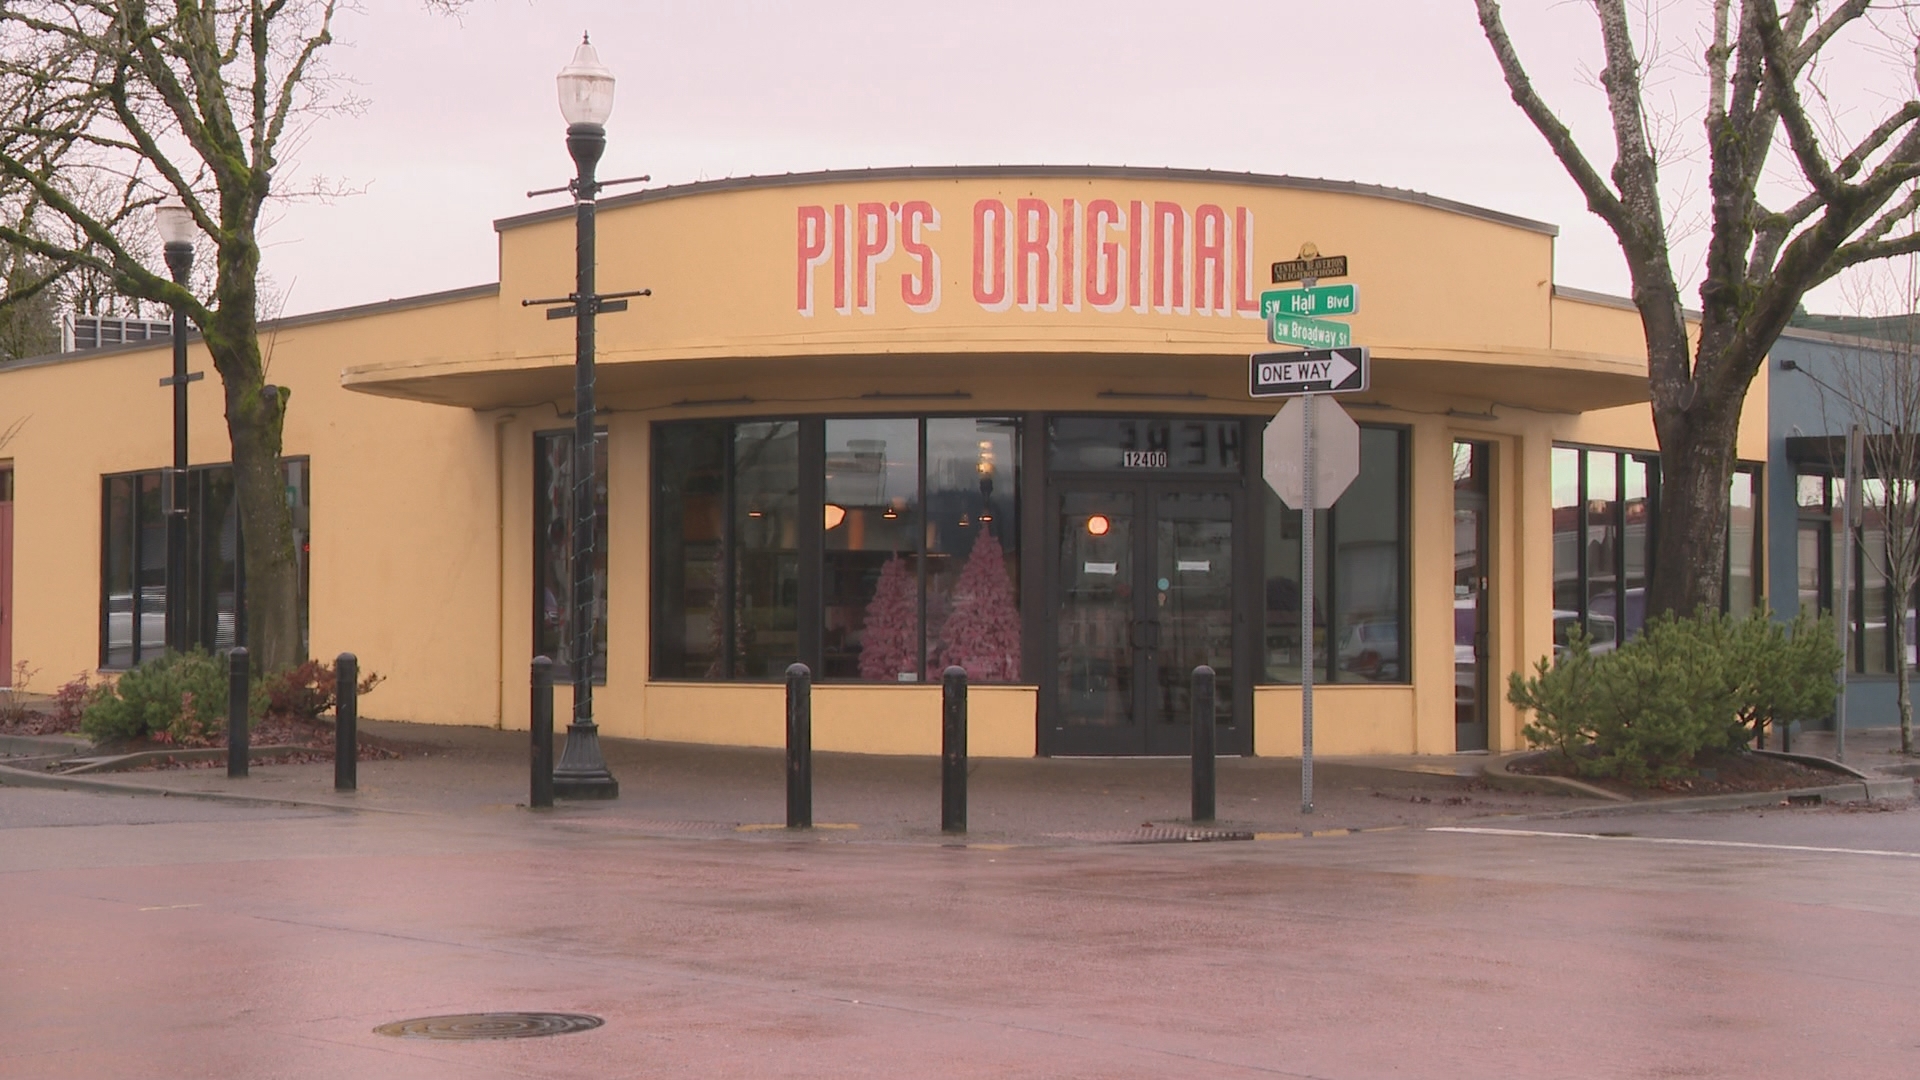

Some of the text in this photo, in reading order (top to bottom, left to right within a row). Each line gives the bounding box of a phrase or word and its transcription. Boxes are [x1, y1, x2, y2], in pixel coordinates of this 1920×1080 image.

[797, 198, 1261, 319] PIP'S ORIGINAL
[1274, 257, 1344, 274] CENTRAL BEAVERTON
[1276, 268, 1343, 281] NEIGHBORHOOD
[1291, 294, 1316, 312] Hall
[1327, 295, 1350, 309] Blvd
[1291, 321, 1337, 346] Broadway
[1339, 332, 1348, 345] St
[1262, 362, 1332, 382] ONE WAY
[1125, 452, 1167, 466] 12400
